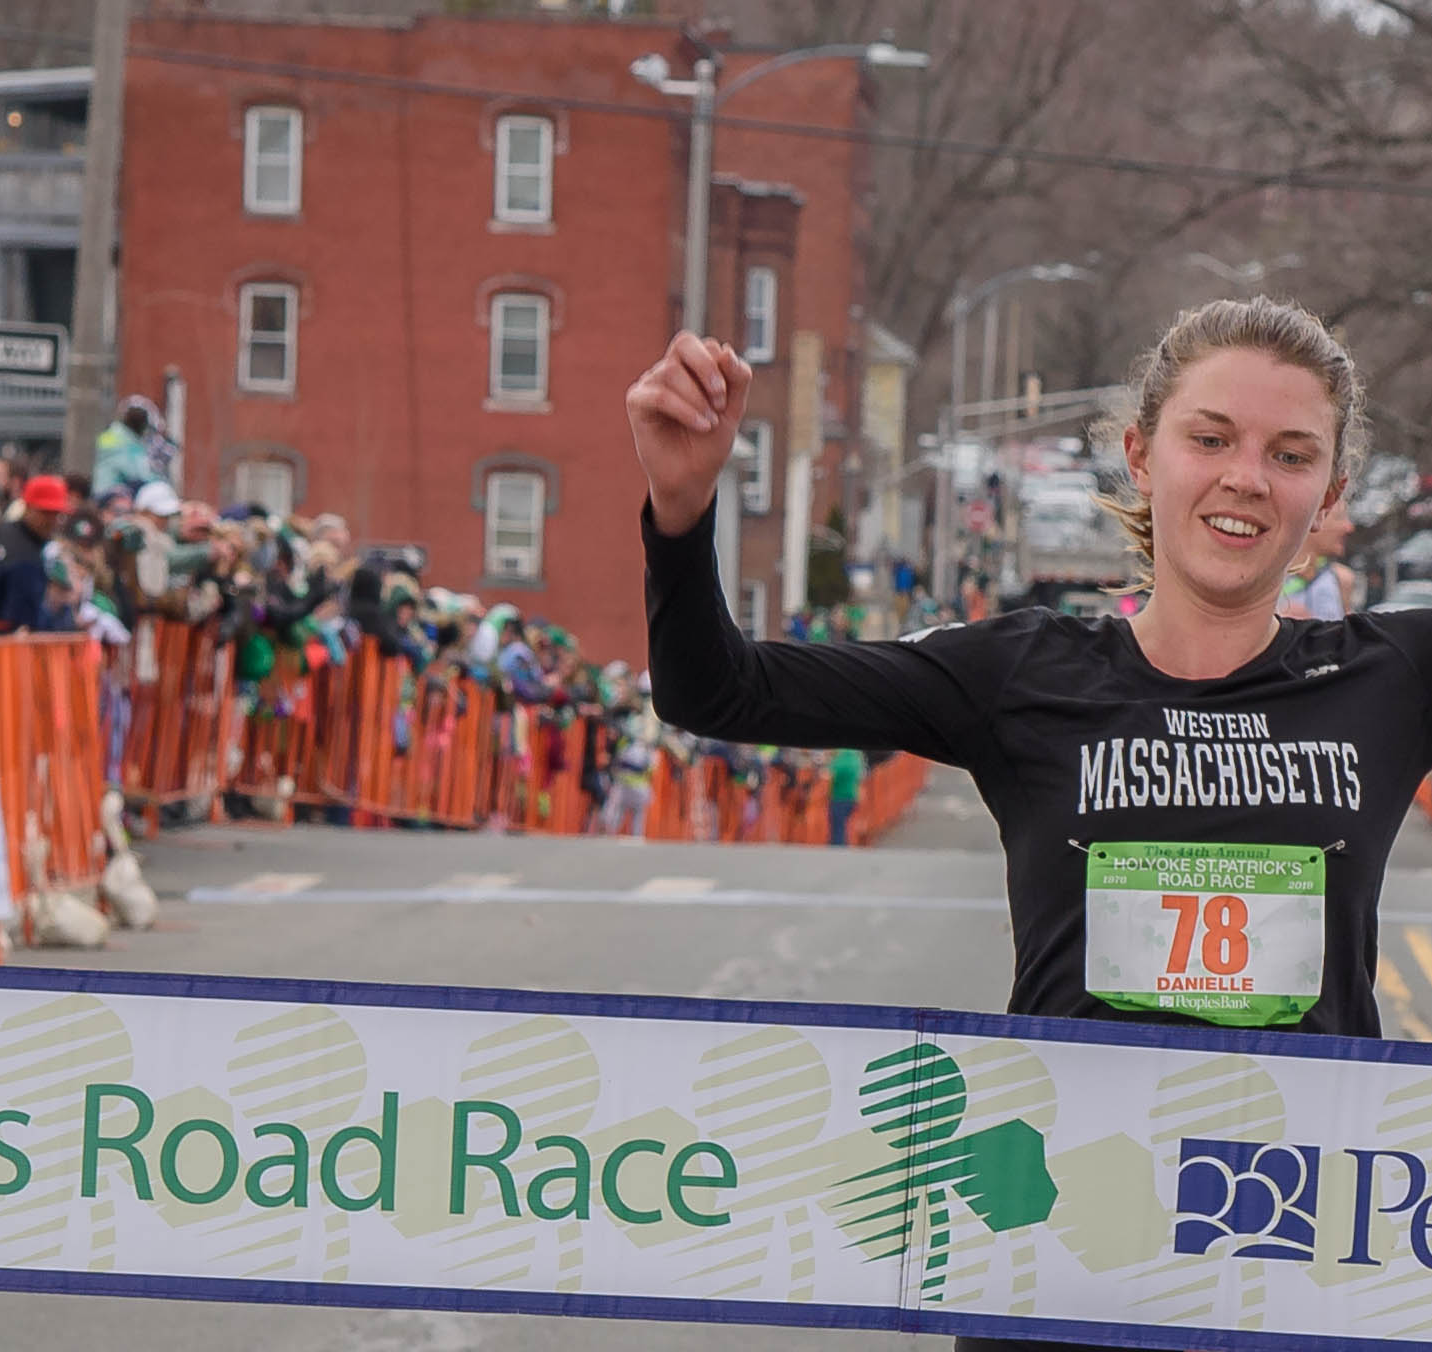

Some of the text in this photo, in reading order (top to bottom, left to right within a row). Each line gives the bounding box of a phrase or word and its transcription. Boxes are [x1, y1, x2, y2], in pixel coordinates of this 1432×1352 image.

[1162, 708, 1270, 739] WESTERN
[1077, 738, 1361, 815] MASSACHUSETTS
[1144, 846, 1271, 859] The 44th Annual
[1113, 856, 1192, 873] HOLYOKE
[1157, 872, 1256, 889] ROAD RACE
[1161, 894, 1249, 976] 78
[1157, 976, 1255, 992] DANIELLE
[1175, 994, 1251, 1012] PeoplesBank
[79, 1082, 399, 1213] Road
[448, 1100, 738, 1228] Race
